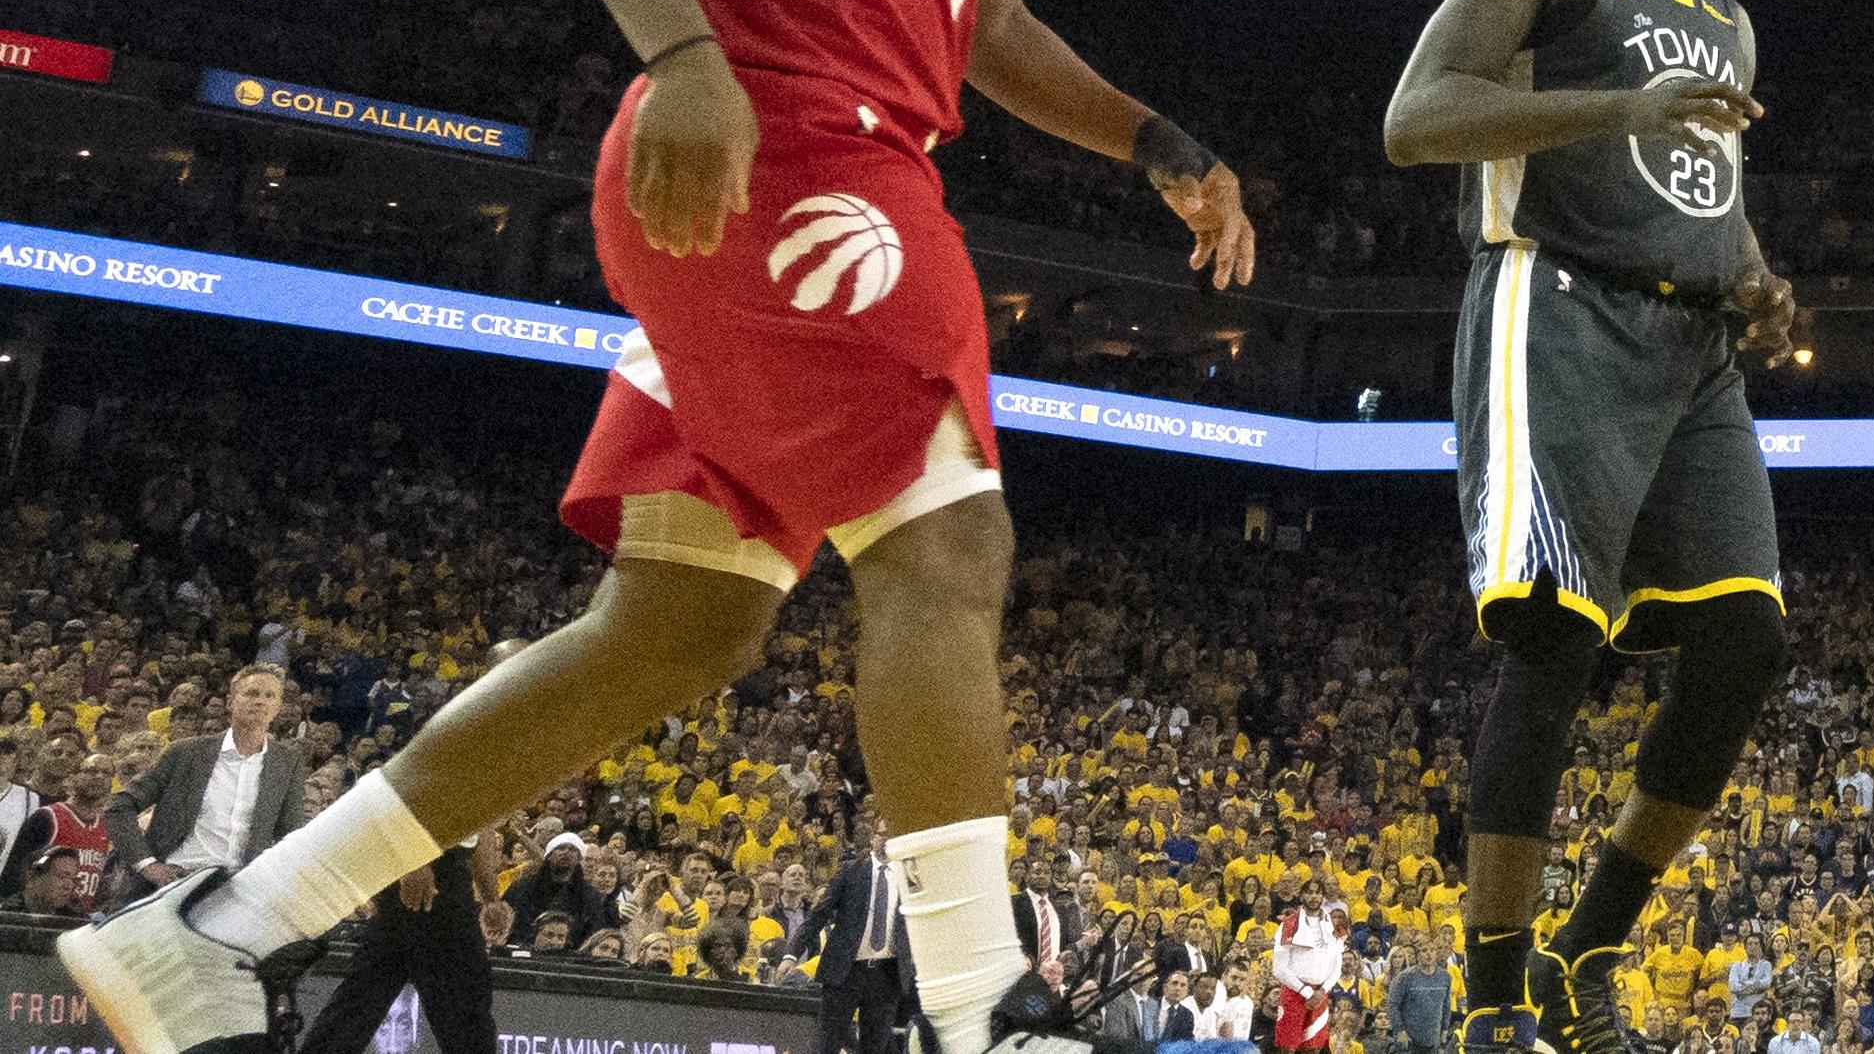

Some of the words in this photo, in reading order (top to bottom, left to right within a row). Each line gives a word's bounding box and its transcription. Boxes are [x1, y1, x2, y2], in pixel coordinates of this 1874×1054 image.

[271, 89, 354, 121] GOLD
[359, 107, 502, 148] ALLIANCE
[1670, 149, 1716, 207] 23
[0, 244, 97, 277] ASINO
[103, 258, 222, 295] RESORT
[361, 296, 464, 331] CACHE
[472, 313, 569, 347] CREEK
[995, 391, 1077, 422] CREEK
[1102, 409, 1186, 437] CASINO
[1190, 420, 1267, 448] RESORT
[1758, 434, 1806, 454] ORT
[8, 991, 88, 1025] FROM
[498, 1034, 625, 1054] TREAMING
